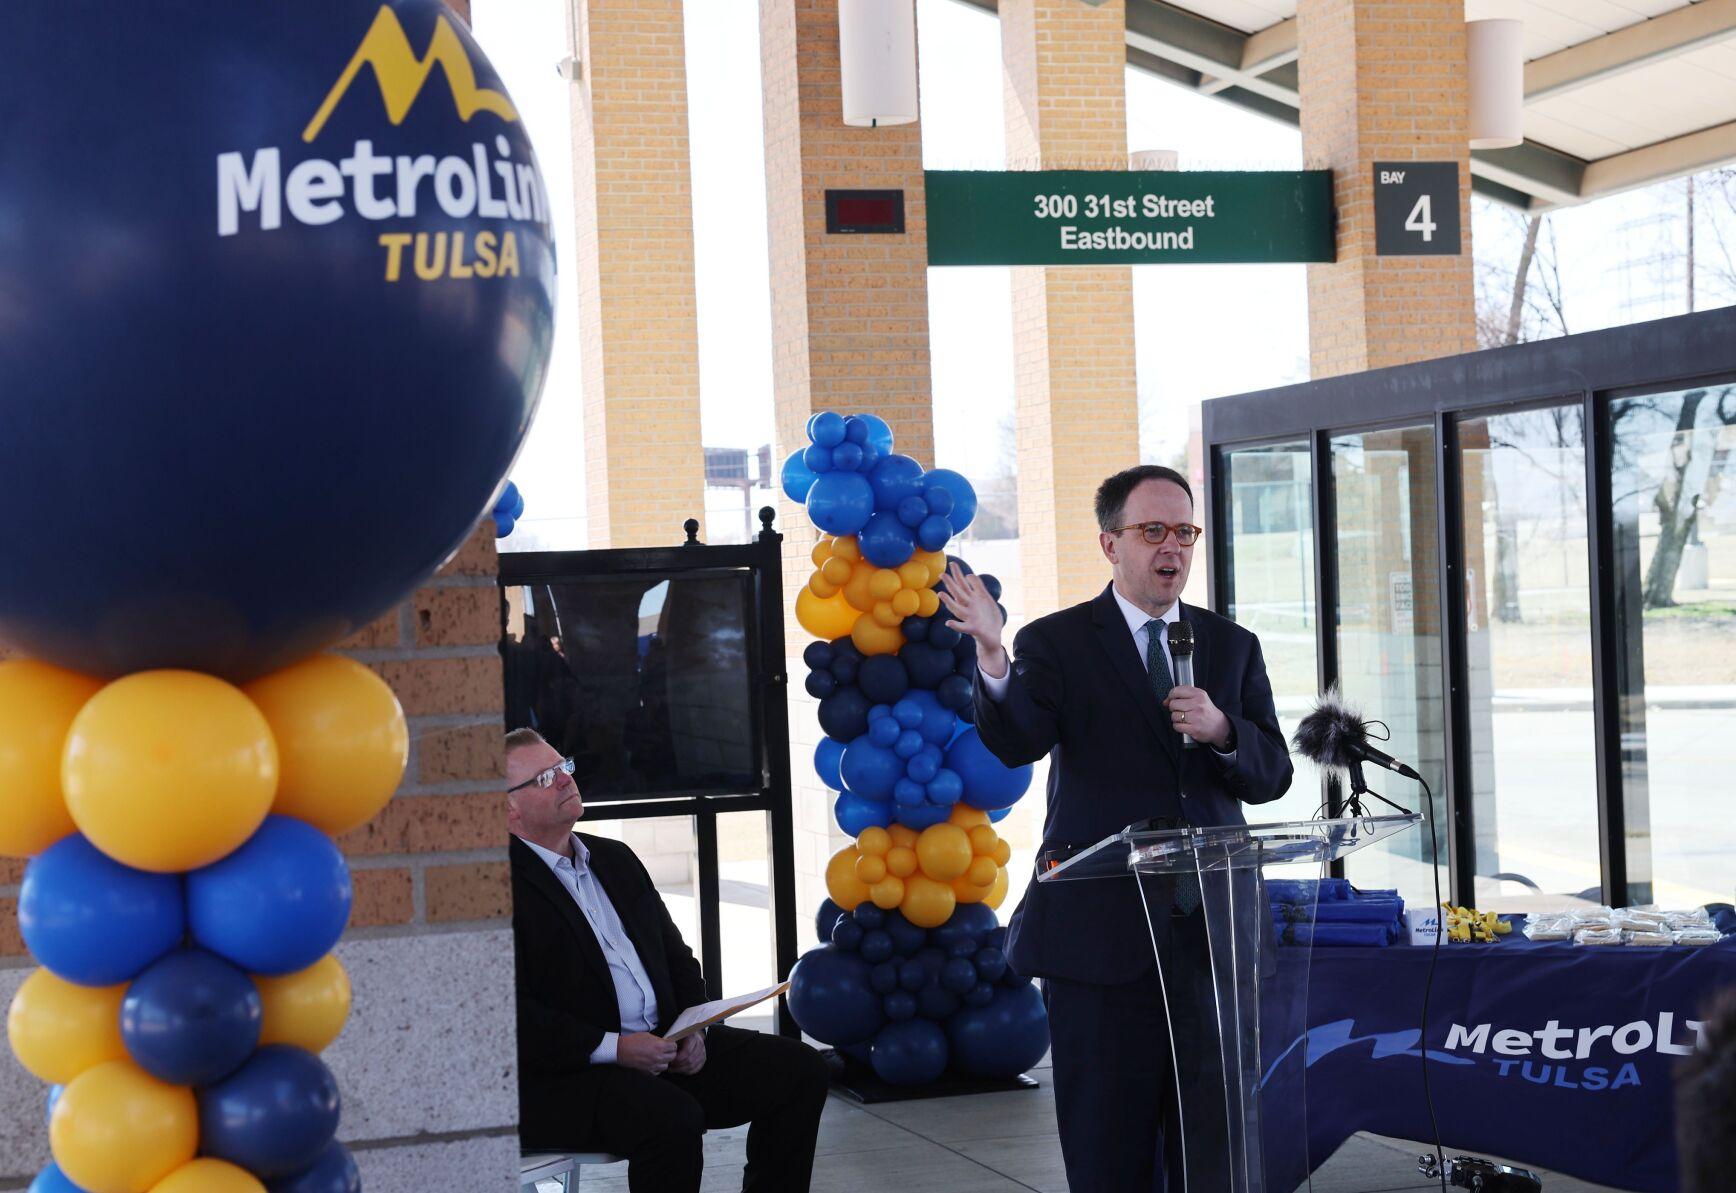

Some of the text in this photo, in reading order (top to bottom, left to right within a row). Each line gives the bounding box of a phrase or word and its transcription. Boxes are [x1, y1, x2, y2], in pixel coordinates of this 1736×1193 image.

[1380, 171, 1406, 184] BAY
[1034, 193, 1215, 218] 300 31st Street
[1405, 194, 1437, 241] 4
[1060, 226, 1194, 249] Eastbound
[379, 231, 519, 281] TULSA
[1492, 1058, 1642, 1091] TULSA
